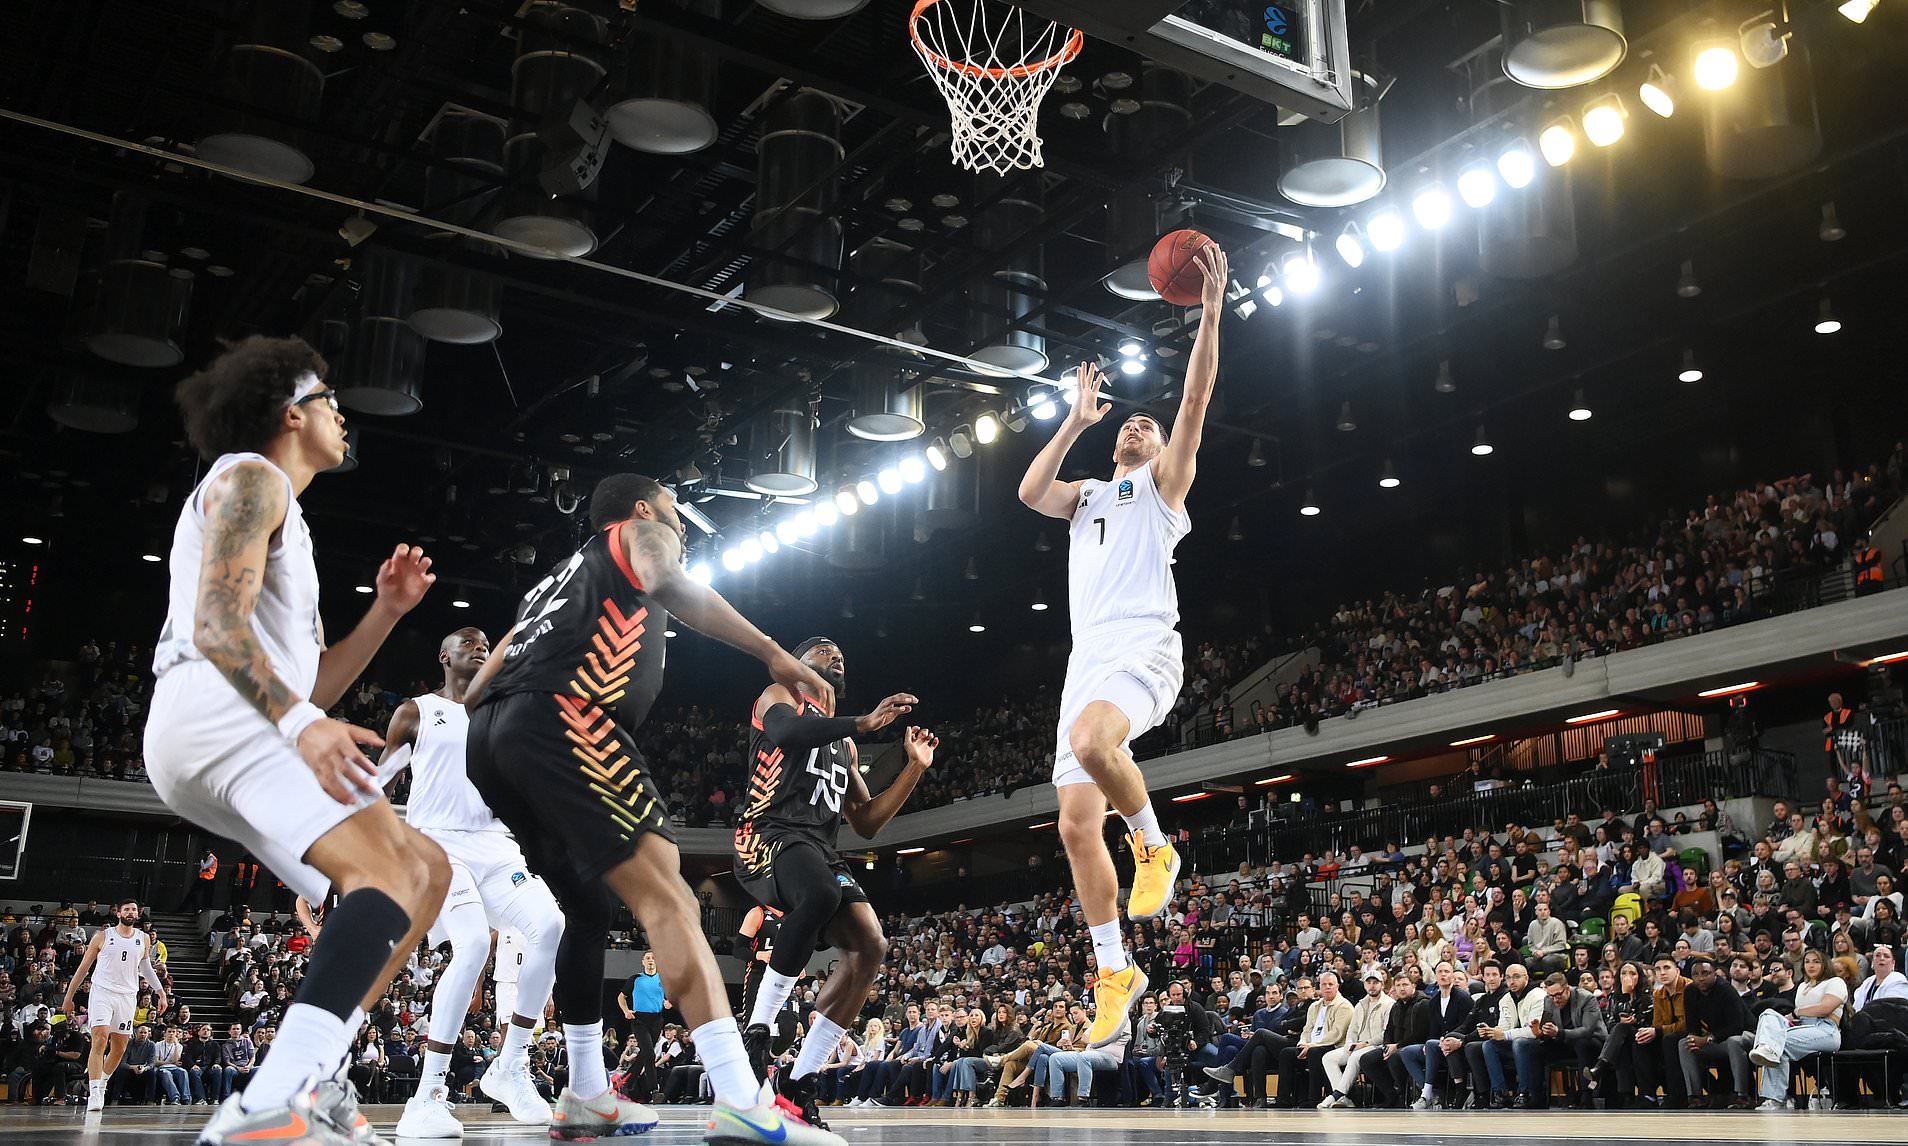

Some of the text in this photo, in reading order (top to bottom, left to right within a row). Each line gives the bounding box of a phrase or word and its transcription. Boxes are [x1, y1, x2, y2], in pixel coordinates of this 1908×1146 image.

[1262, 33, 1292, 54] BKT
[1093, 517, 1106, 545] 7
[512, 551, 585, 636] 22
[121, 950, 128, 962] 8
[516, 952, 523, 965] 0
[126, 1020, 132, 1031] 8
